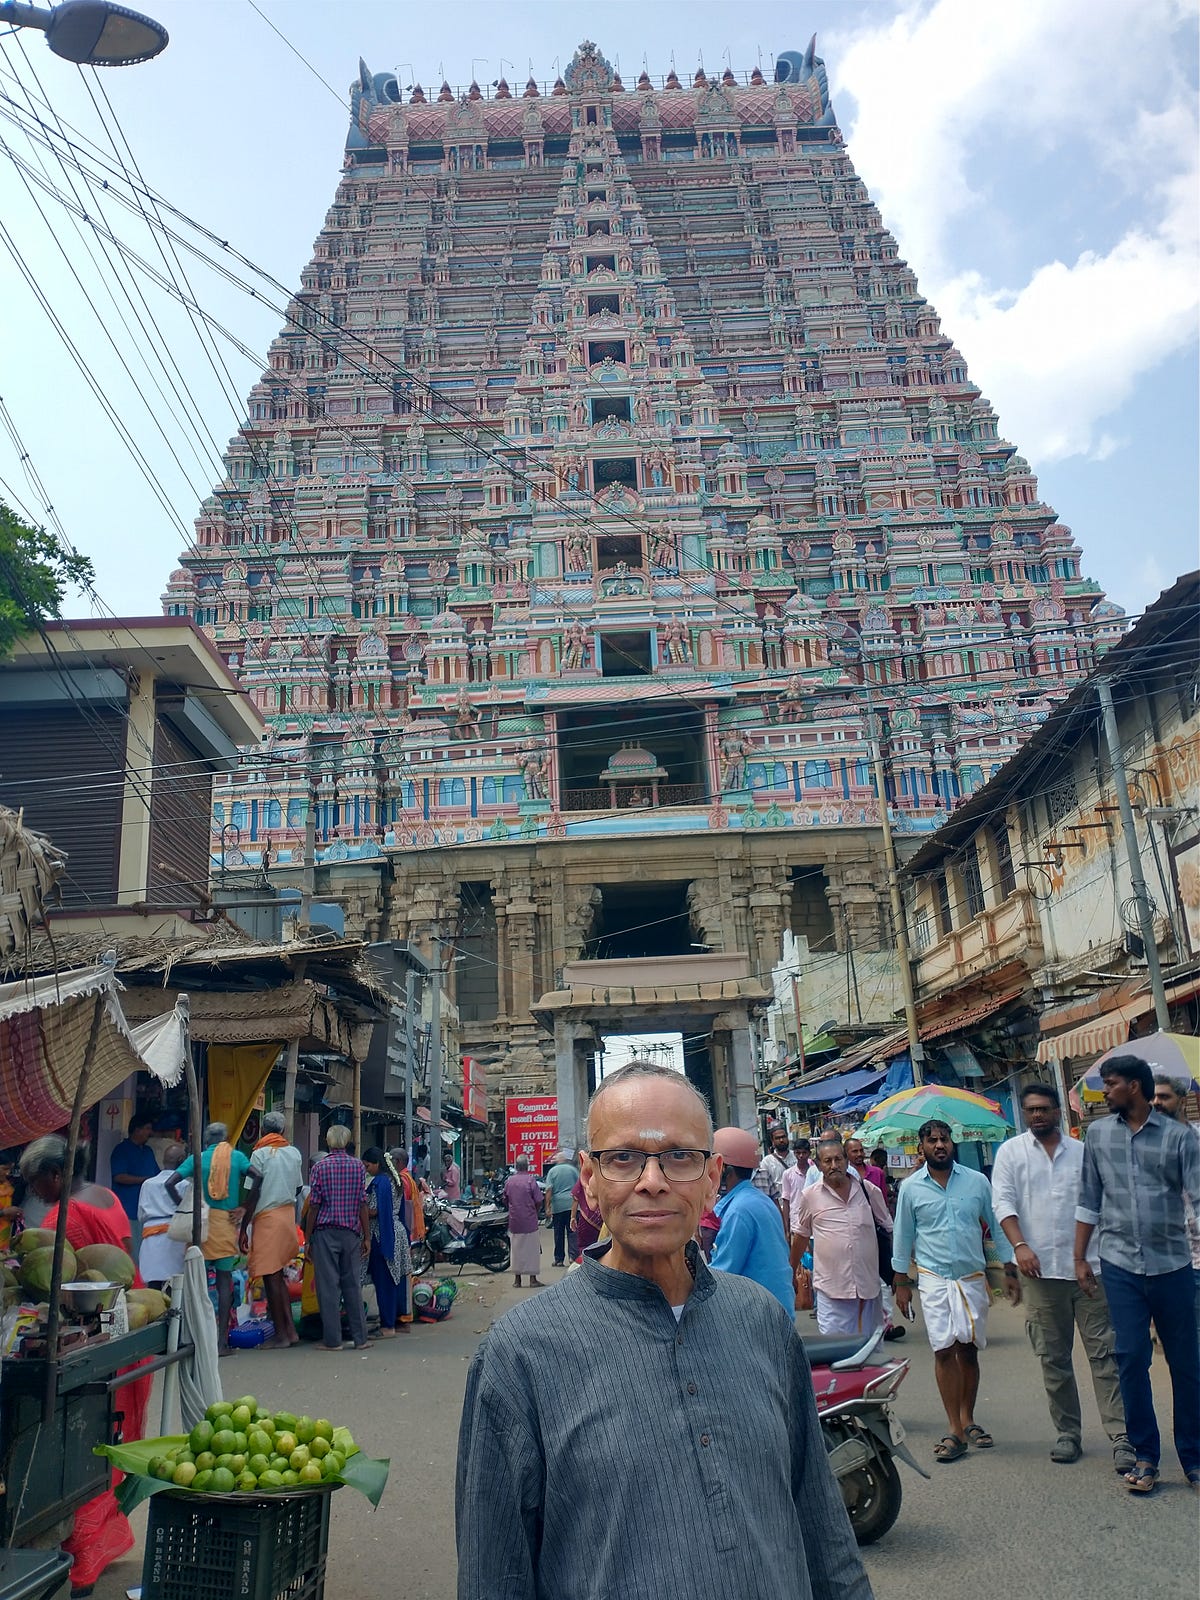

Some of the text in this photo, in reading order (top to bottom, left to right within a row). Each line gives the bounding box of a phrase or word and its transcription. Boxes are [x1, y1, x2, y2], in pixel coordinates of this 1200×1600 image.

[521, 1132, 556, 1140] HOTEL
[153, 1527, 164, 1583] OM BRAND
[241, 1540, 252, 1594] OM BRAND
